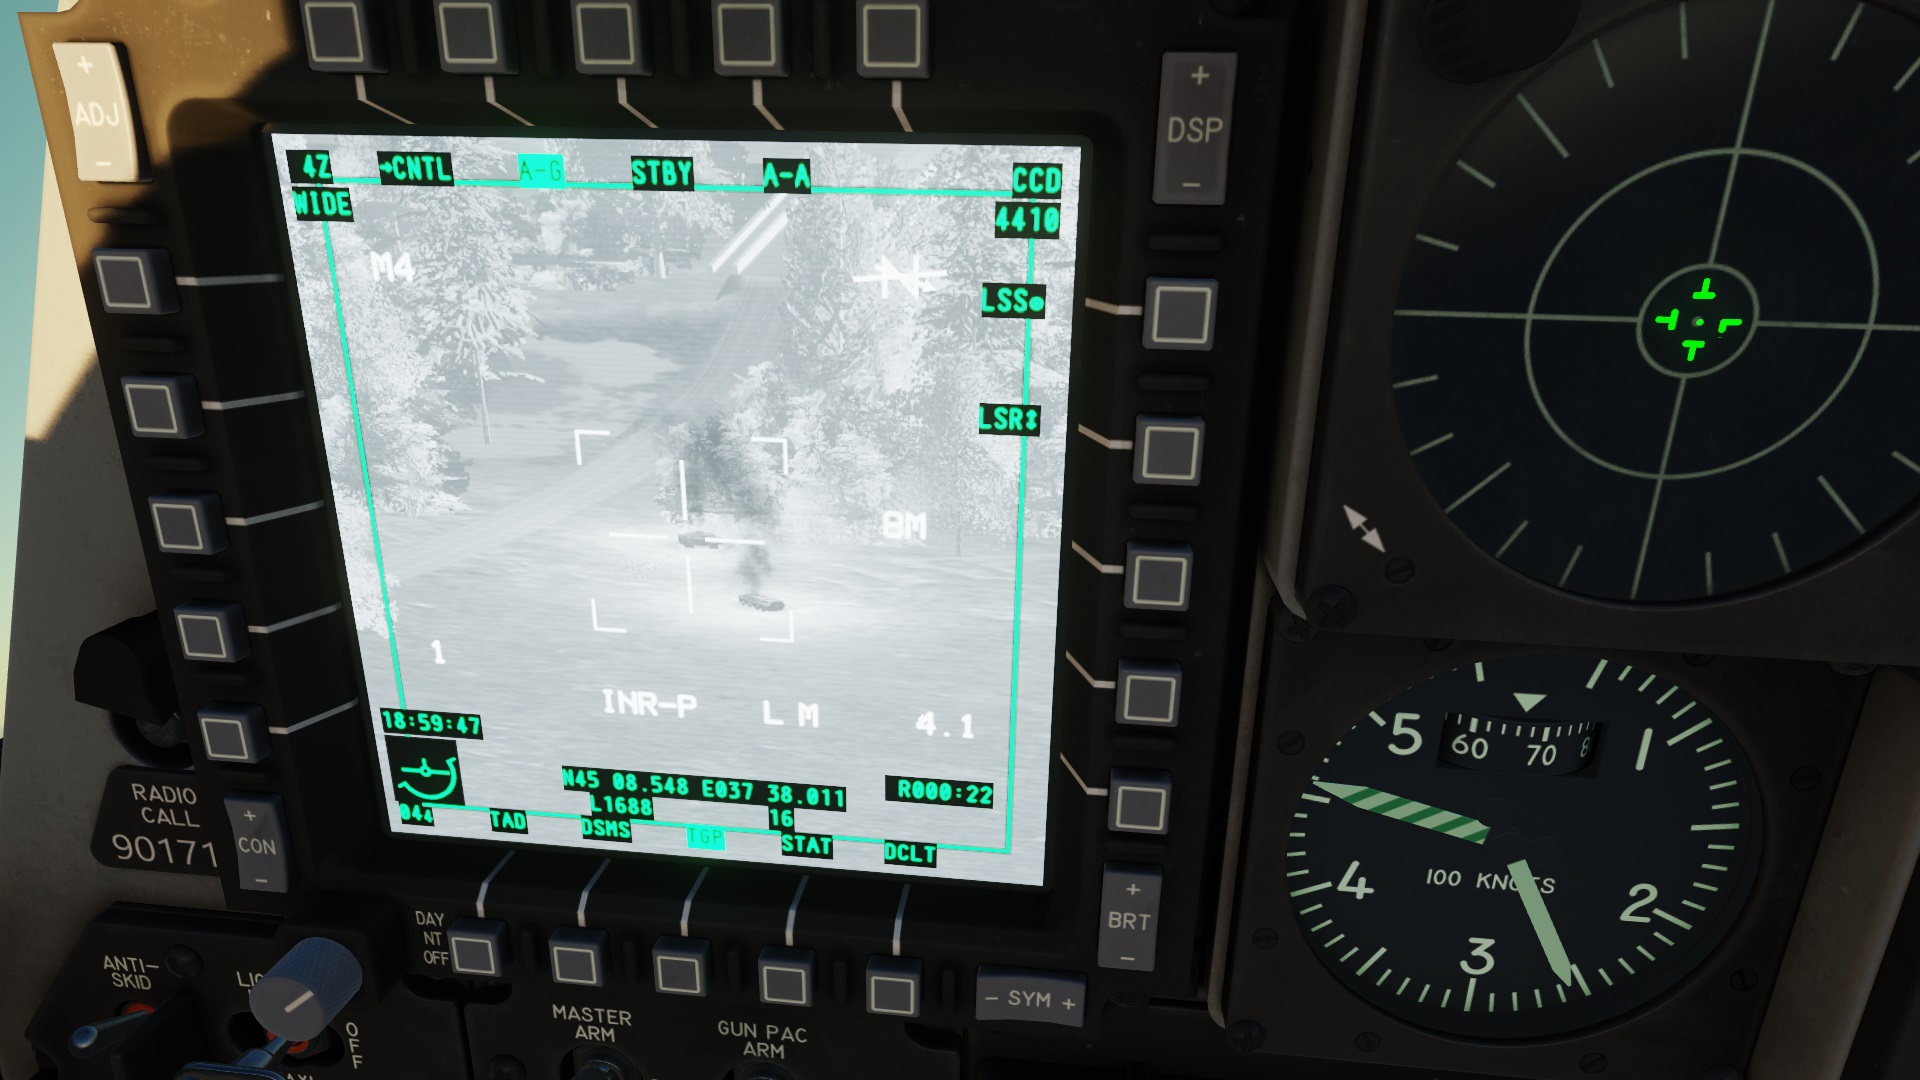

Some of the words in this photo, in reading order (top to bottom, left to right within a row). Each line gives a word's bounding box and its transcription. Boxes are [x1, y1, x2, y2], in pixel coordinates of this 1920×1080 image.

[75, 101, 119, 127] ADJ
[1167, 116, 1223, 143] DSP
[303, 154, 332, 178] 4Z
[392, 156, 452, 181] CNTL
[518, 158, 563, 182] A-G
[631, 159, 692, 185] STBY
[763, 161, 811, 188] A-A
[1012, 166, 1062, 194] CCD
[295, 190, 352, 217] WIDE
[995, 208, 1060, 234] 4410
[369, 250, 415, 283] M4
[981, 286, 1029, 313] LSS
[978, 405, 1023, 431] LSR
[431, 639, 446, 665] 1
[602, 688, 697, 719] INR-P
[382, 710, 481, 736] 18:59:47
[916, 711, 975, 739] 4.1
[1387, 712, 1423, 756] 5
[1451, 733, 1489, 760] 60
[1526, 744, 1557, 766] 70
[1634, 727, 1653, 771] 1
[131, 783, 197, 805] RADIO
[562, 768, 600, 789] N45
[612, 772, 689, 796] 08.548
[702, 778, 753, 801] E037
[767, 784, 844, 808] 38.011
[898, 779, 993, 806] R000:22
[141, 807, 201, 828] CALL
[399, 803, 434, 823] 044
[590, 793, 653, 817] L1688
[490, 810, 527, 830] TAD
[581, 818, 631, 839] DSMS
[769, 808, 794, 828] 16
[238, 837, 277, 856] CON
[687, 827, 723, 845] TGP
[781, 835, 833, 855] STAT
[111, 833, 218, 868] 90171
[884, 842, 936, 864] DCLT
[1337, 860, 1375, 900] 4
[1426, 868, 1462, 886] 100
[1476, 872, 1556, 894] KNS
[1619, 883, 1659, 923] 2
[415, 911, 444, 927] DAY
[1108, 911, 1152, 931] BRT
[423, 931, 442, 947] NT
[103, 955, 160, 974] ANTI-
[423, 950, 449, 966] OFF
[1459, 937, 1496, 976] 3
[111, 972, 151, 990] SKID
[1008, 990, 1051, 1008] SYM
[552, 1003, 633, 1027] MASTER
[574, 1024, 616, 1043] ARM
[717, 1020, 758, 1039] GUN
[765, 1024, 808, 1043] PAC
[742, 1041, 786, 1060] ARM
